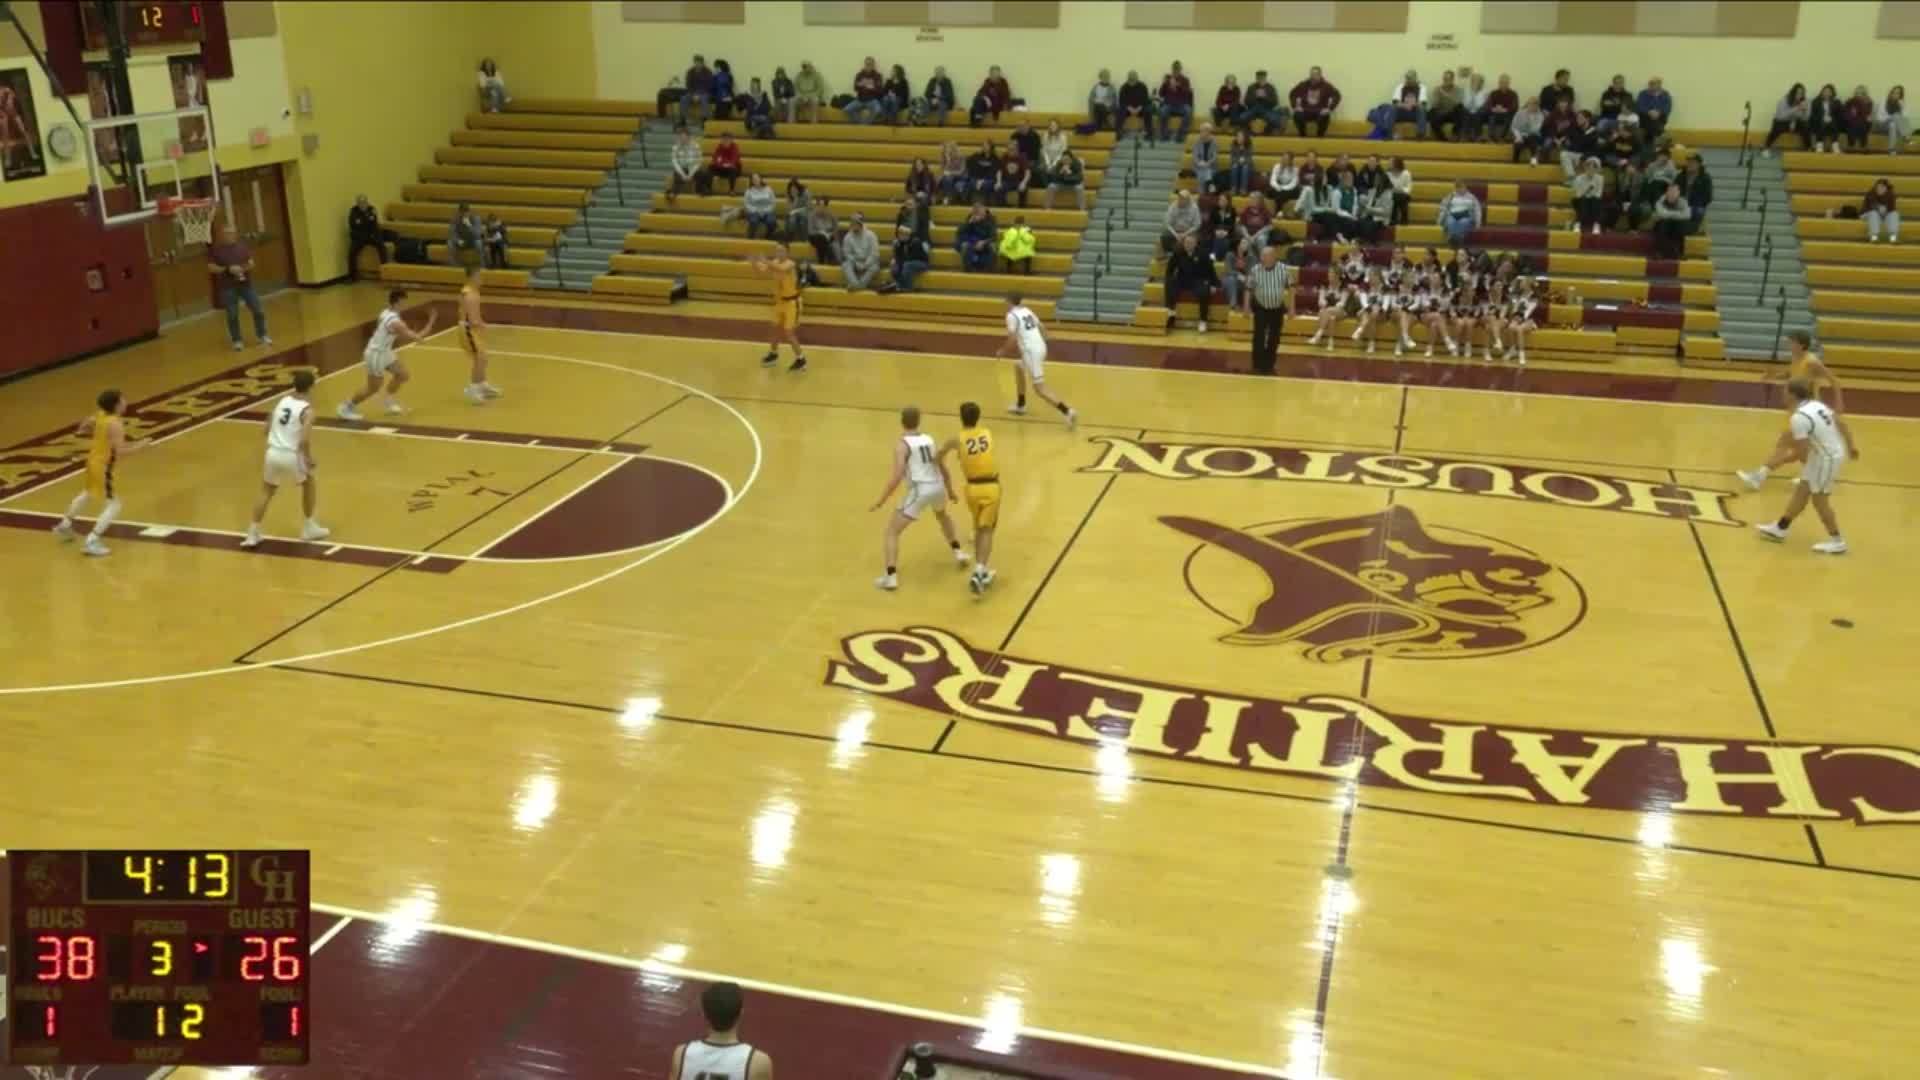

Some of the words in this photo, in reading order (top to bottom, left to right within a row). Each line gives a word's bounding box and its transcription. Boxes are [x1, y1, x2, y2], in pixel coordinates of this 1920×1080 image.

[279, 407, 292, 426] 3
[919, 445, 935, 465] 11
[966, 435, 989, 456] 25
[1080, 438, 1745, 527] HOUSTON
[832, 626, 1920, 823] CHARTIERS
